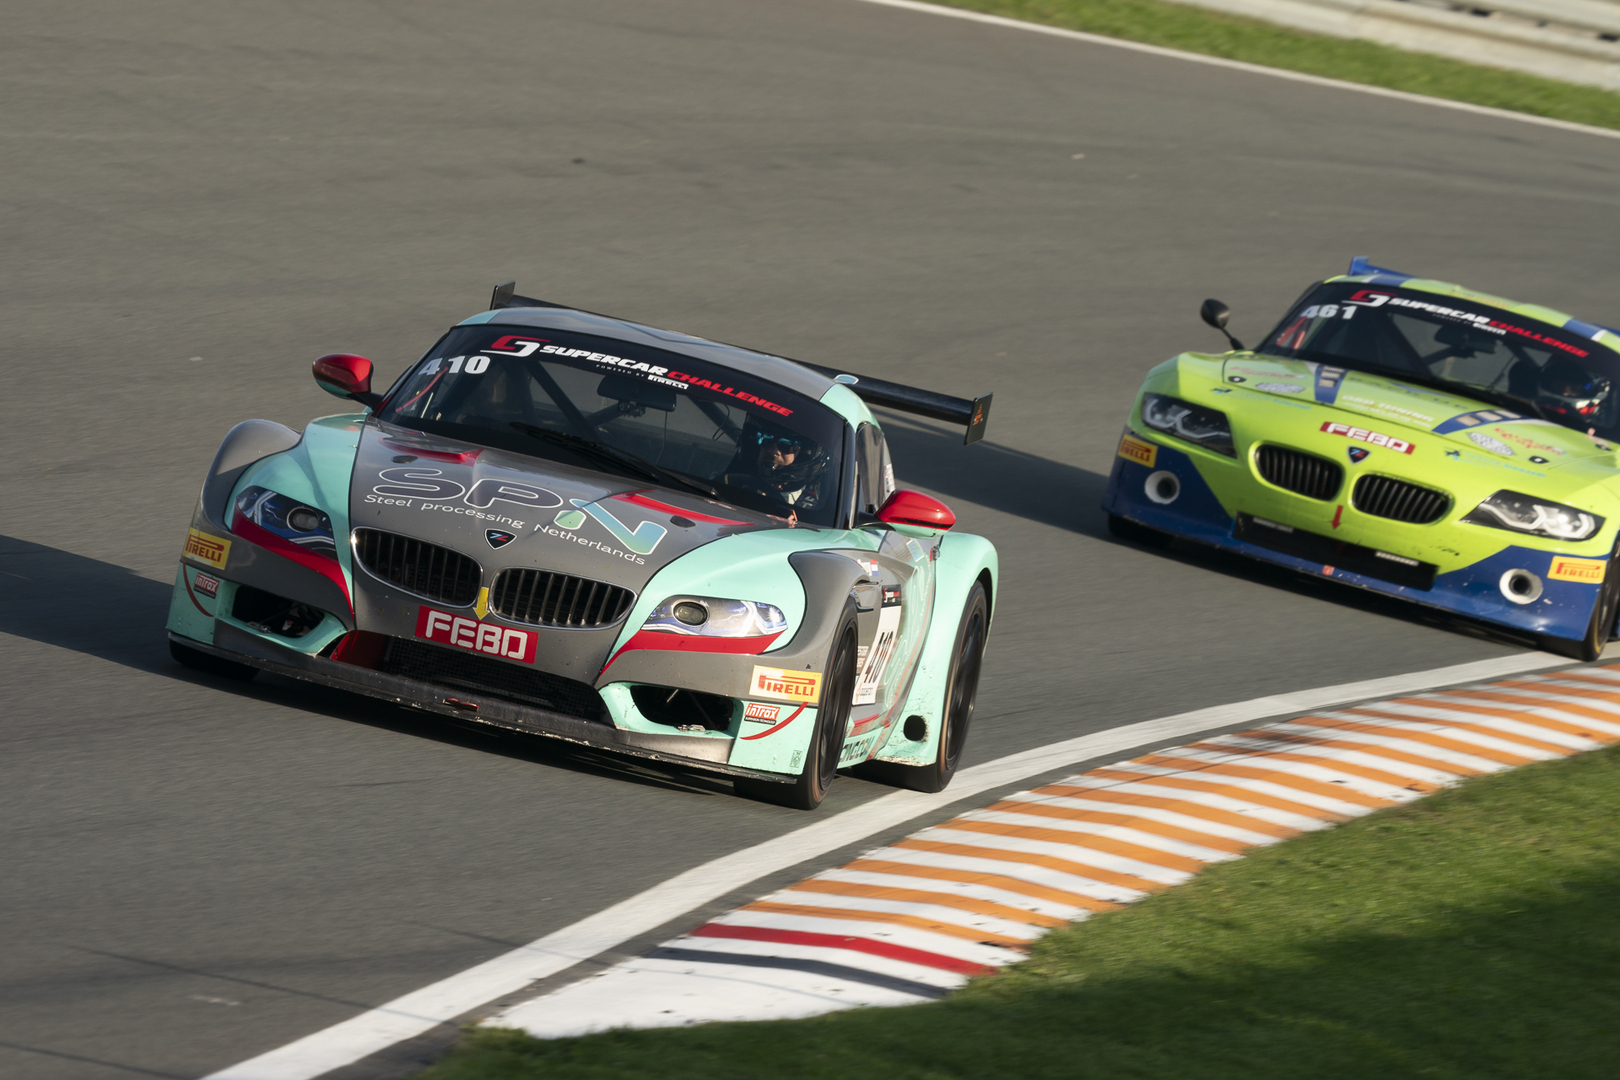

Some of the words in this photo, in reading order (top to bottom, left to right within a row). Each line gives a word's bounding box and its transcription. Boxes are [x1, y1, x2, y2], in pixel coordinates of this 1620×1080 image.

[1300, 304, 1357, 319] 461
[1387, 298, 1491, 324] SUPERCAR
[1488, 320, 1590, 358] CHALLENGE
[418, 355, 491, 375] 410
[539, 344, 669, 376] SUPERCAR
[667, 371, 793, 417] CHALLENGE
[1326, 422, 1410, 453] FEBO
[364, 494, 412, 507] Steel
[421, 502, 526, 528] processing
[534, 524, 646, 565] Netherlands
[185, 533, 225, 563] PIRELLI
[1556, 562, 1601, 578] PIRELLI
[425, 610, 528, 660] FEBO
[758, 674, 816, 697] PIRELLI
